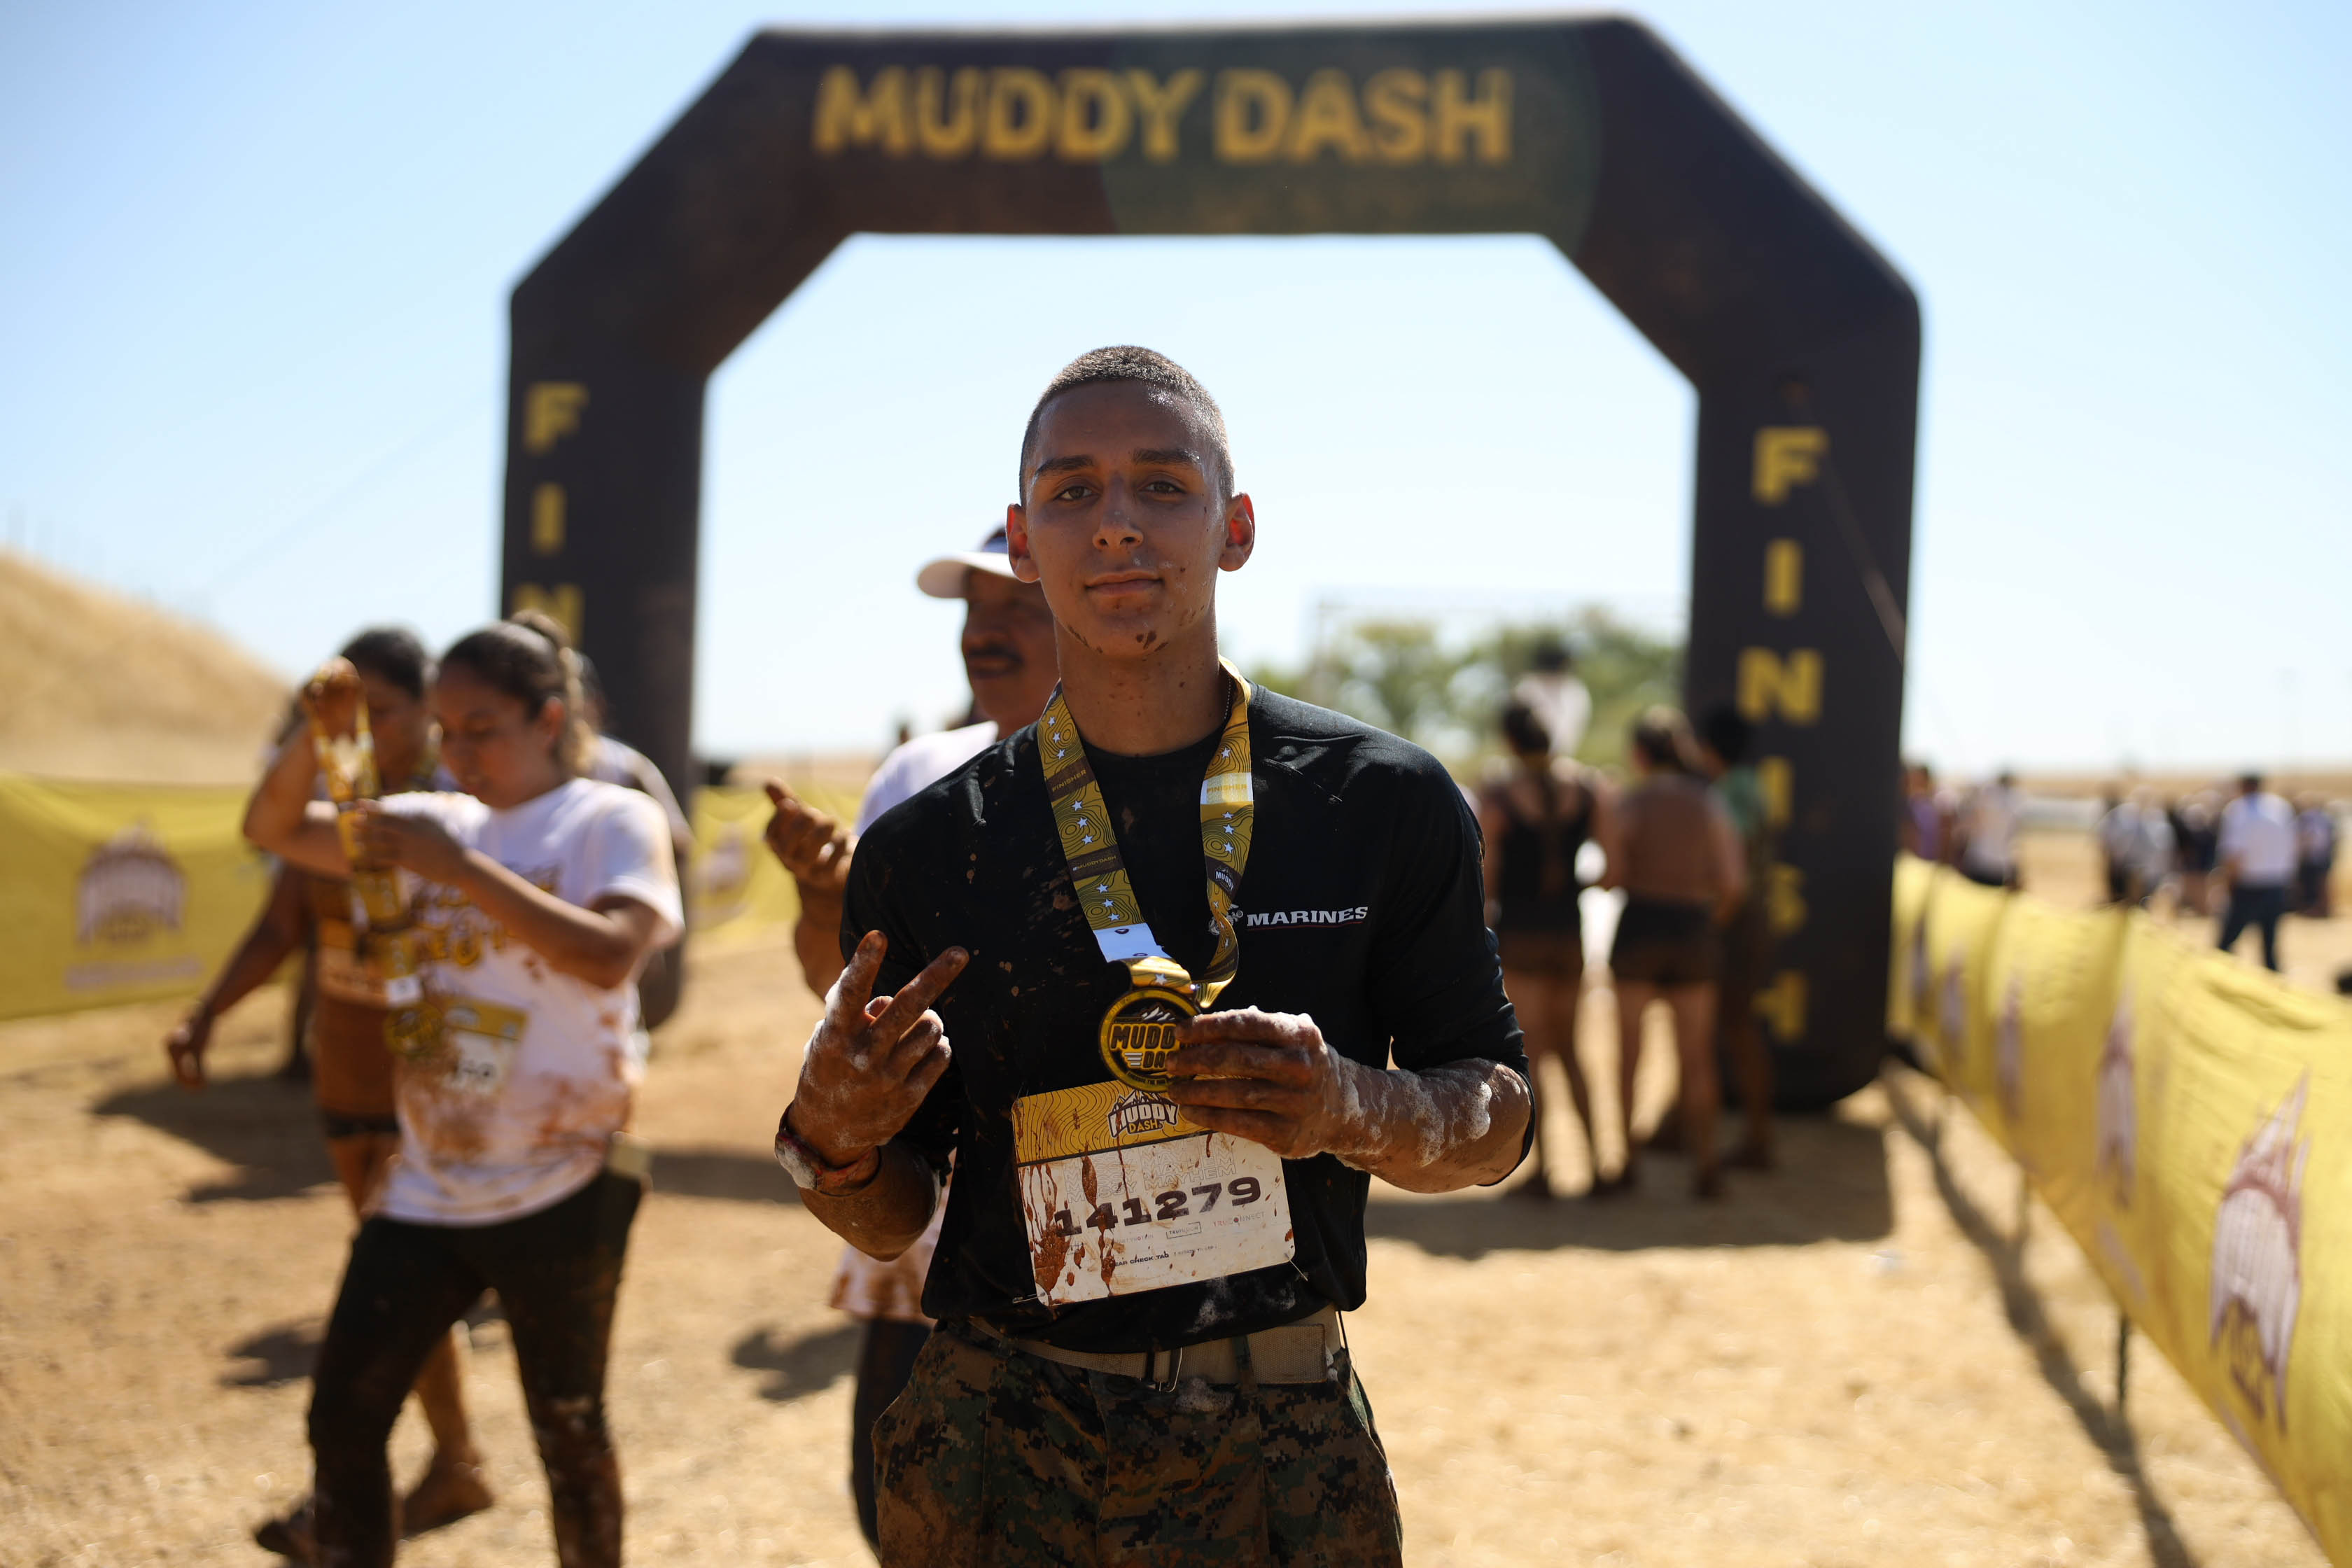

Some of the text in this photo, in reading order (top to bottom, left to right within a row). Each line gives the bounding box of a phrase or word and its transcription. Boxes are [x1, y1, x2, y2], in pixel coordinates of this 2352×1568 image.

[812, 65, 1514, 164] MUDDY DASH
[1052, 769, 1087, 792] FINISHER
[1207, 785, 1247, 794] FINISHER
[1072, 855, 1117, 872] #MUDDYDASH
[1247, 906, 1368, 926] MARINES
[1110, 1025, 1176, 1050] MUDD
[1110, 1103, 1177, 1137] MUDDY
[1128, 1120, 1158, 1133] DASH
[1067, 1181, 1139, 1204] MSSY
[1054, 1176, 1261, 1237] 141279
